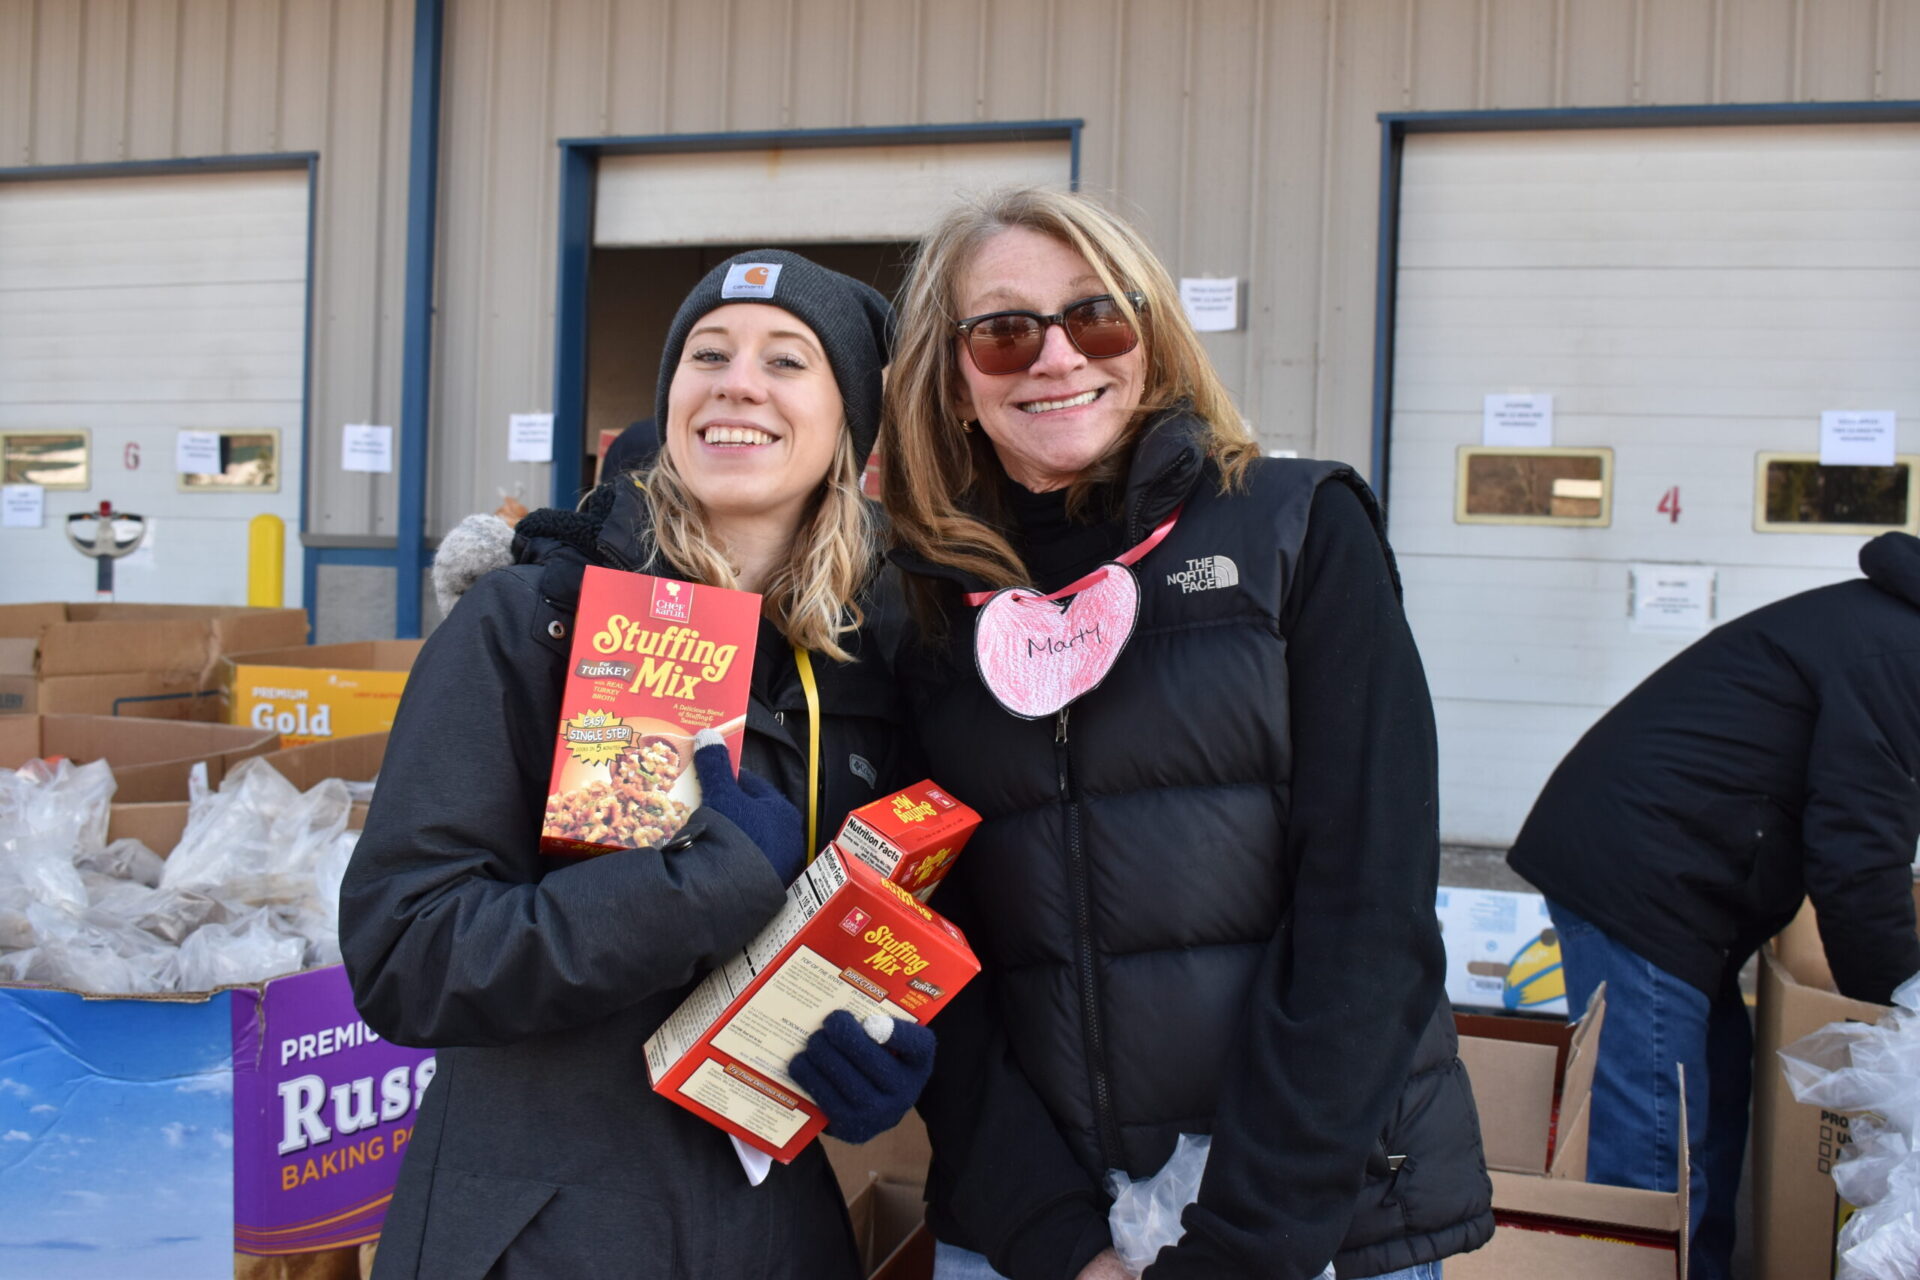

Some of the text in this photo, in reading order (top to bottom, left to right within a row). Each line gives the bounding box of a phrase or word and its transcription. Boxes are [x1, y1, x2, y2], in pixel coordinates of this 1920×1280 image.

[1656, 486, 1682, 523] 4
[1166, 566, 1215, 586] NORTH
[1185, 556, 1214, 571] THE
[1181, 578, 1216, 594] FACE
[592, 614, 739, 682] Stuffing
[1028, 624, 1103, 658] Marty
[581, 665, 631, 677] TURKEY
[628, 657, 702, 700] Mix
[252, 686, 309, 700] PREMIUM
[251, 702, 332, 736] Gold
[583, 716, 607, 727] EASY
[569, 728, 630, 741] SINGLE STEP!
[847, 818, 900, 862] Nutrition Facts
[863, 948, 902, 977] Mix
[864, 925, 930, 976] Stuffing
[844, 970, 886, 998] DIRECTIONS
[910, 979, 941, 997] TURKEY
[281, 1020, 379, 1066] PREMIU
[277, 1056, 437, 1156] Russ
[1820, 1110, 1849, 1128] PRO
[281, 1136, 385, 1191] BAKING
